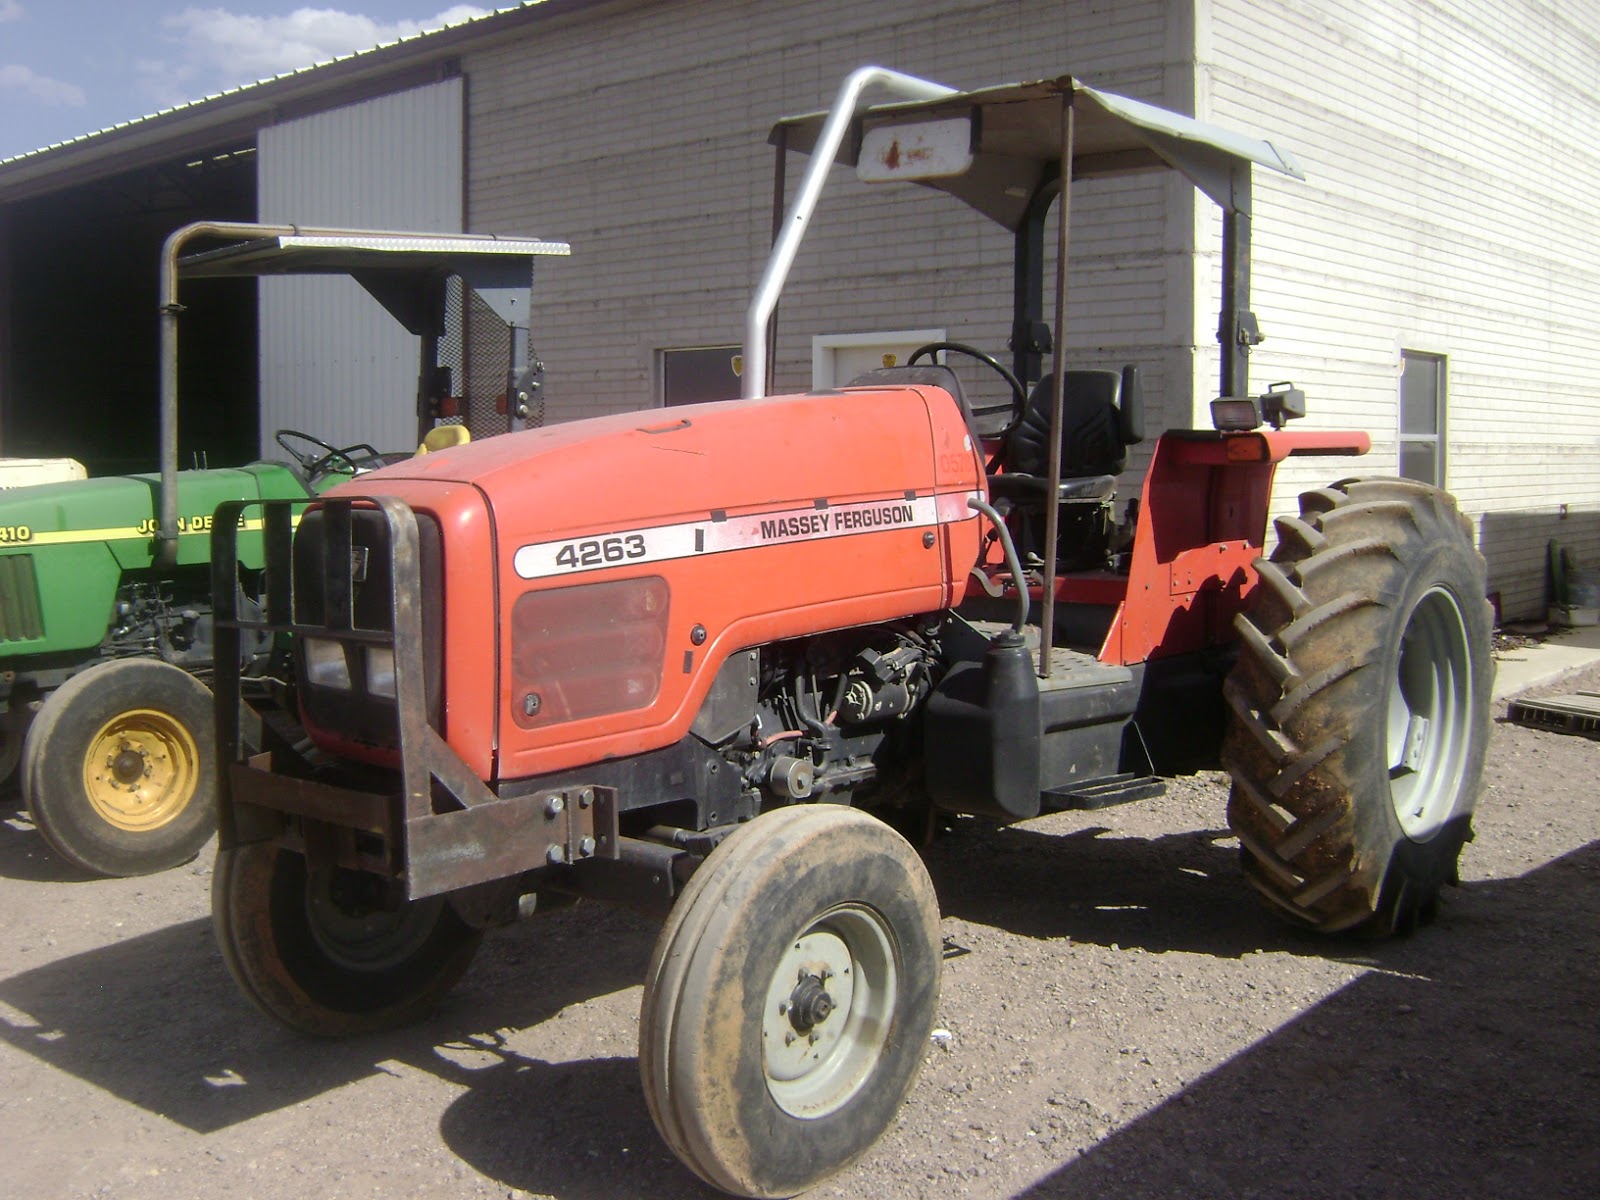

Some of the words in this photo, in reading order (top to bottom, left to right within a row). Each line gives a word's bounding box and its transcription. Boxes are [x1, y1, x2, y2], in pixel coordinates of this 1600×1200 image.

[136, 517, 186, 534] JON
[760, 513, 830, 540] MASSEY
[834, 505, 914, 530] FERGUSON
[555, 534, 647, 568] 4263
